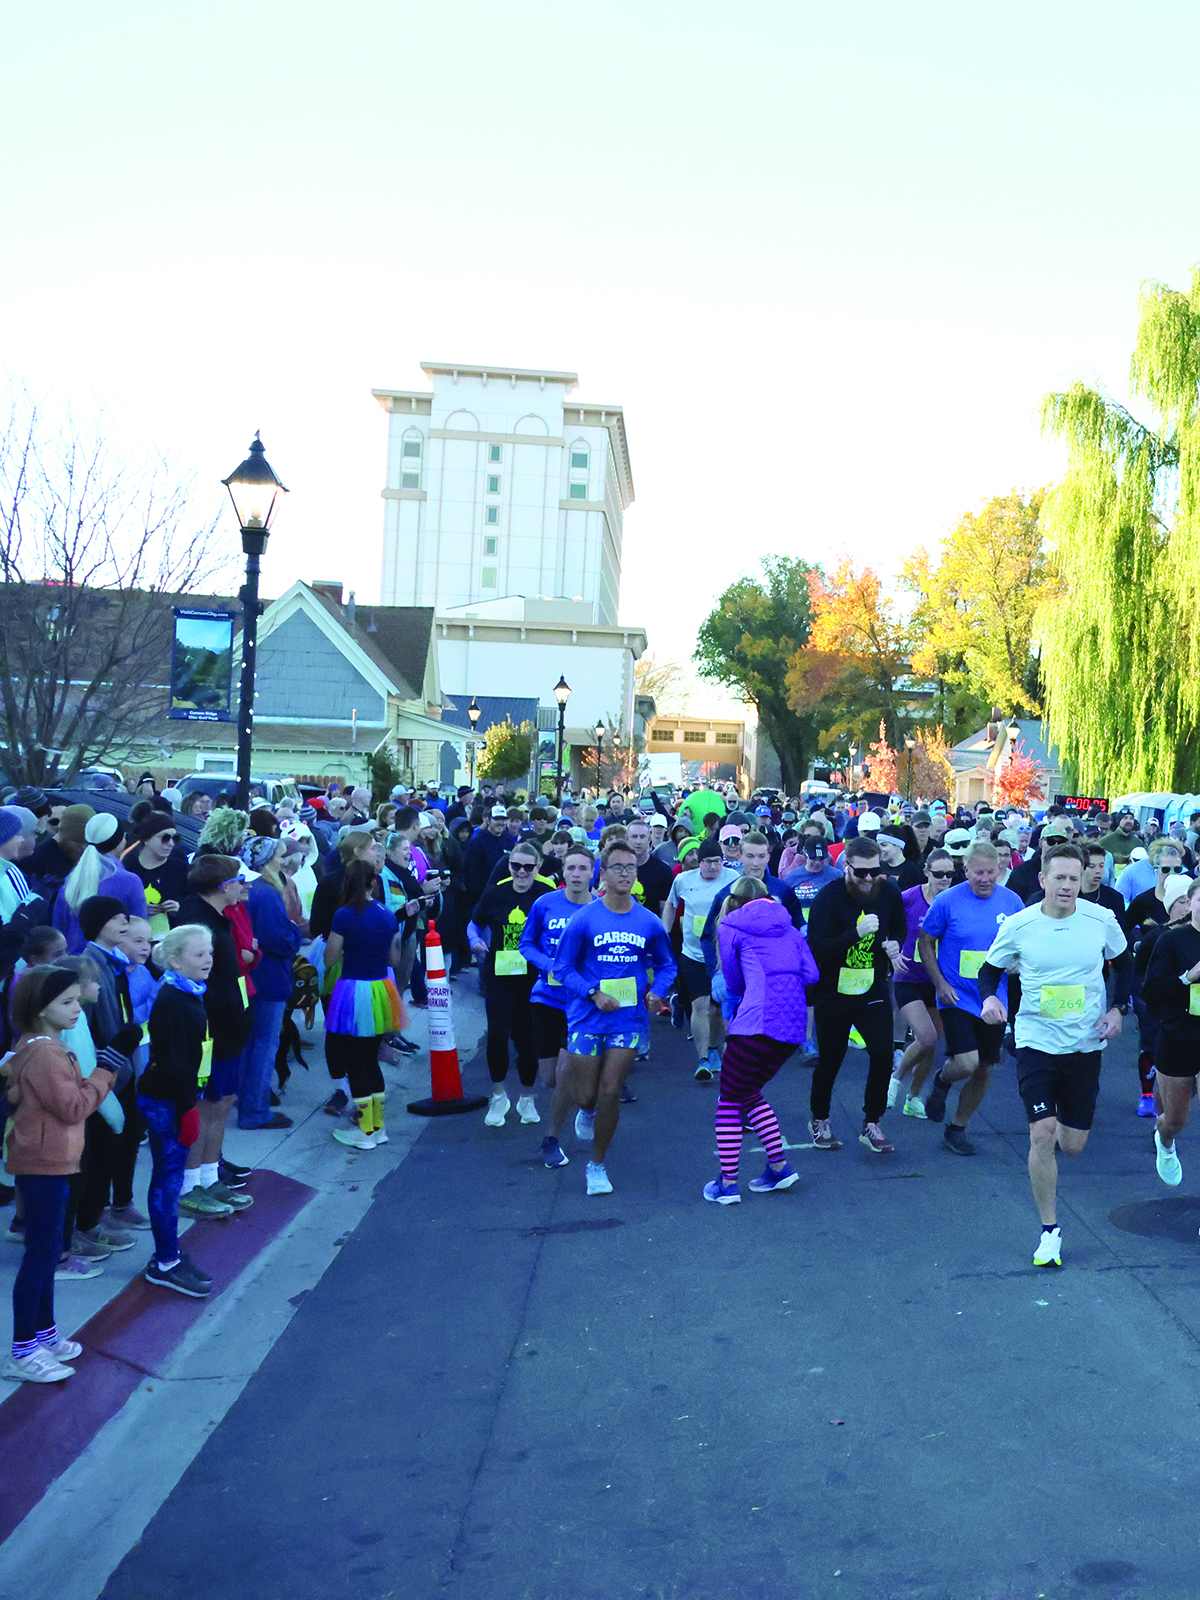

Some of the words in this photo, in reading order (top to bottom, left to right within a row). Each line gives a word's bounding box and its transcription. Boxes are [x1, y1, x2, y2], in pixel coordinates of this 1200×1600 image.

[593, 931, 647, 949] CARSON
[597, 954, 639, 963] SENATORS
[426, 986, 450, 997] PORARY
[619, 989, 632, 998] 110
[1058, 998, 1082, 1009] 264
